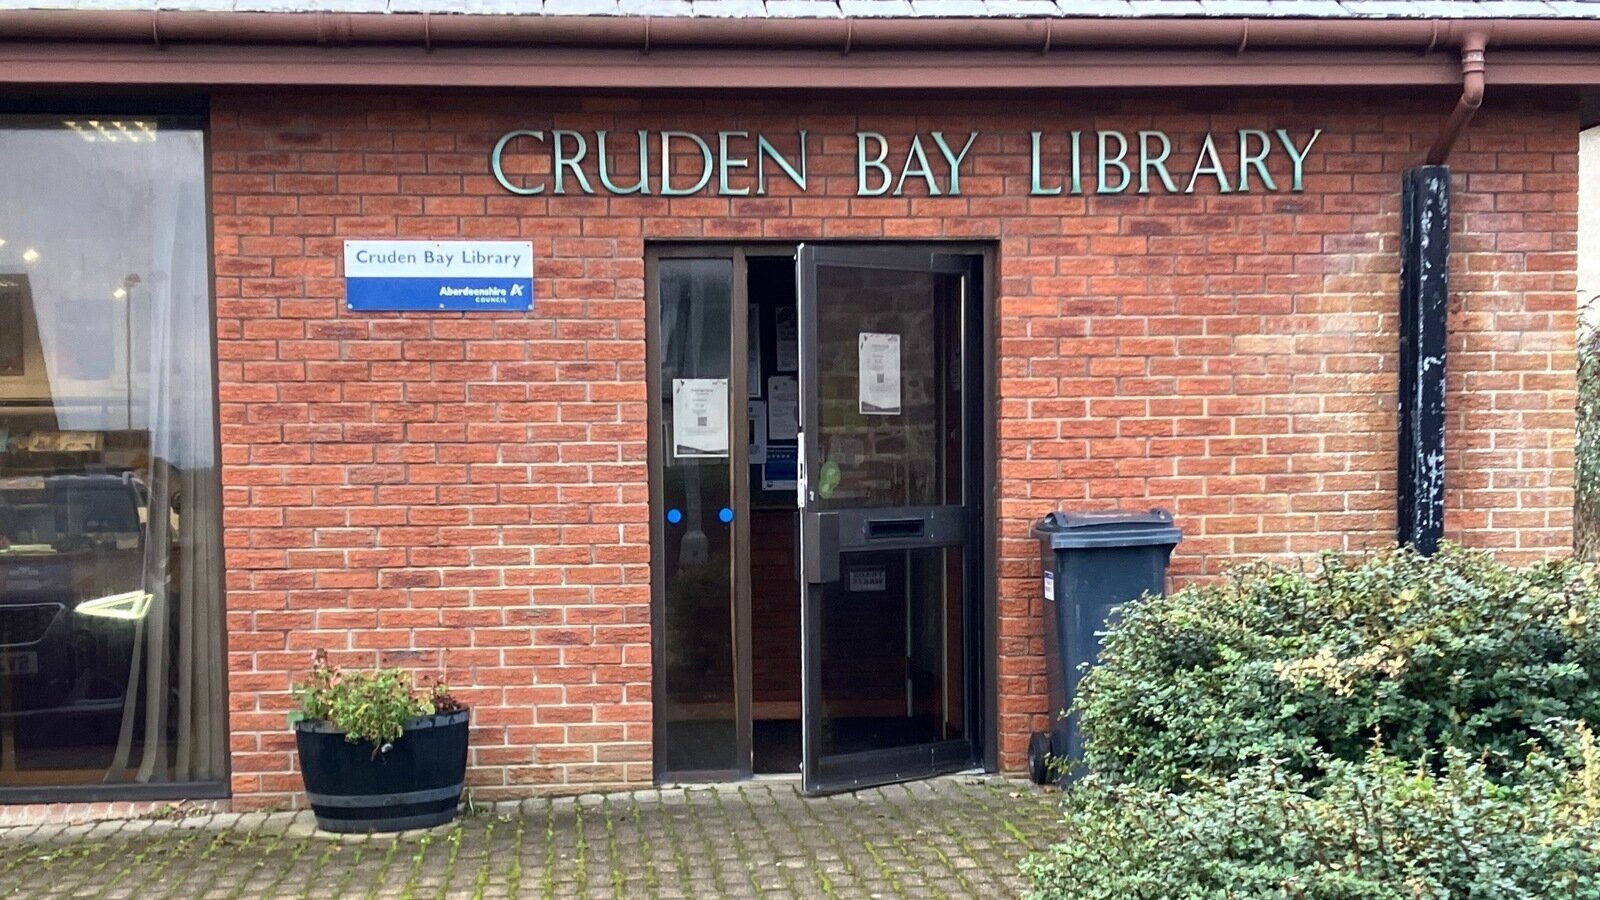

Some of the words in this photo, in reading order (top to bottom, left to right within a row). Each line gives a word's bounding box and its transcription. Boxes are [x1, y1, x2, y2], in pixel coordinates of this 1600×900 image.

[491, 128, 807, 196] CRUDEN
[855, 129, 979, 196] BAY
[1029, 127, 1322, 195] LIBRARY
[356, 250, 417, 264] Cruden
[424, 250, 454, 267] Bay
[462, 250, 521, 267] Library
[439, 286, 507, 297] Aberdeenshire
[475, 296, 507, 304] COUNCIL
